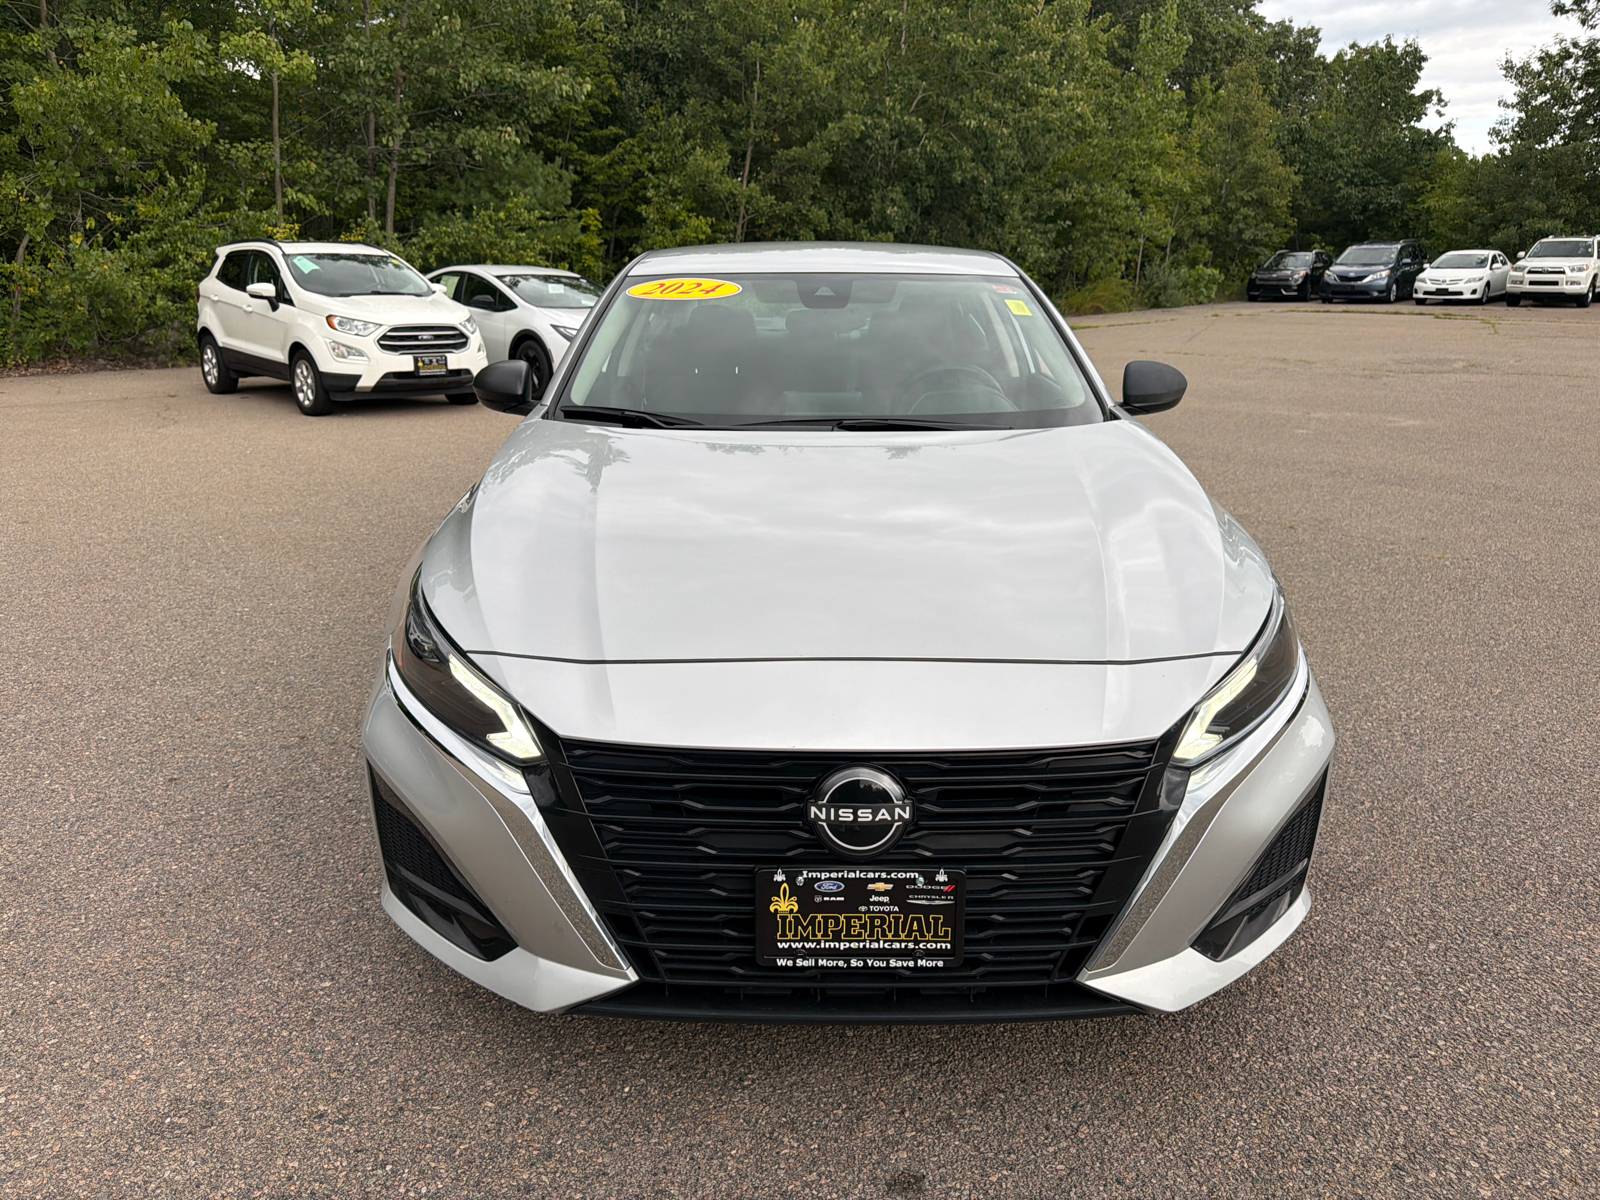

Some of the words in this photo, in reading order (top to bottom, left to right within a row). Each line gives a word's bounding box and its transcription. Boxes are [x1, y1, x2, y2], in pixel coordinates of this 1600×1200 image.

[639, 282, 726, 295] 2024
[810, 806, 910, 821] NISSAN
[802, 870, 919, 879] Imperialcars.com
[869, 895, 890, 903] Jeep
[777, 914, 951, 940] IMPERIAL
[777, 940, 951, 950] www.imperialcars.com
[776, 958, 793, 967] We
[795, 958, 815, 967] Sell
[818, 958, 847, 969] More,
[850, 958, 864, 967] So
[866, 958, 887, 967] You
[889, 958, 915, 967] Save
[917, 958, 944, 967] More
